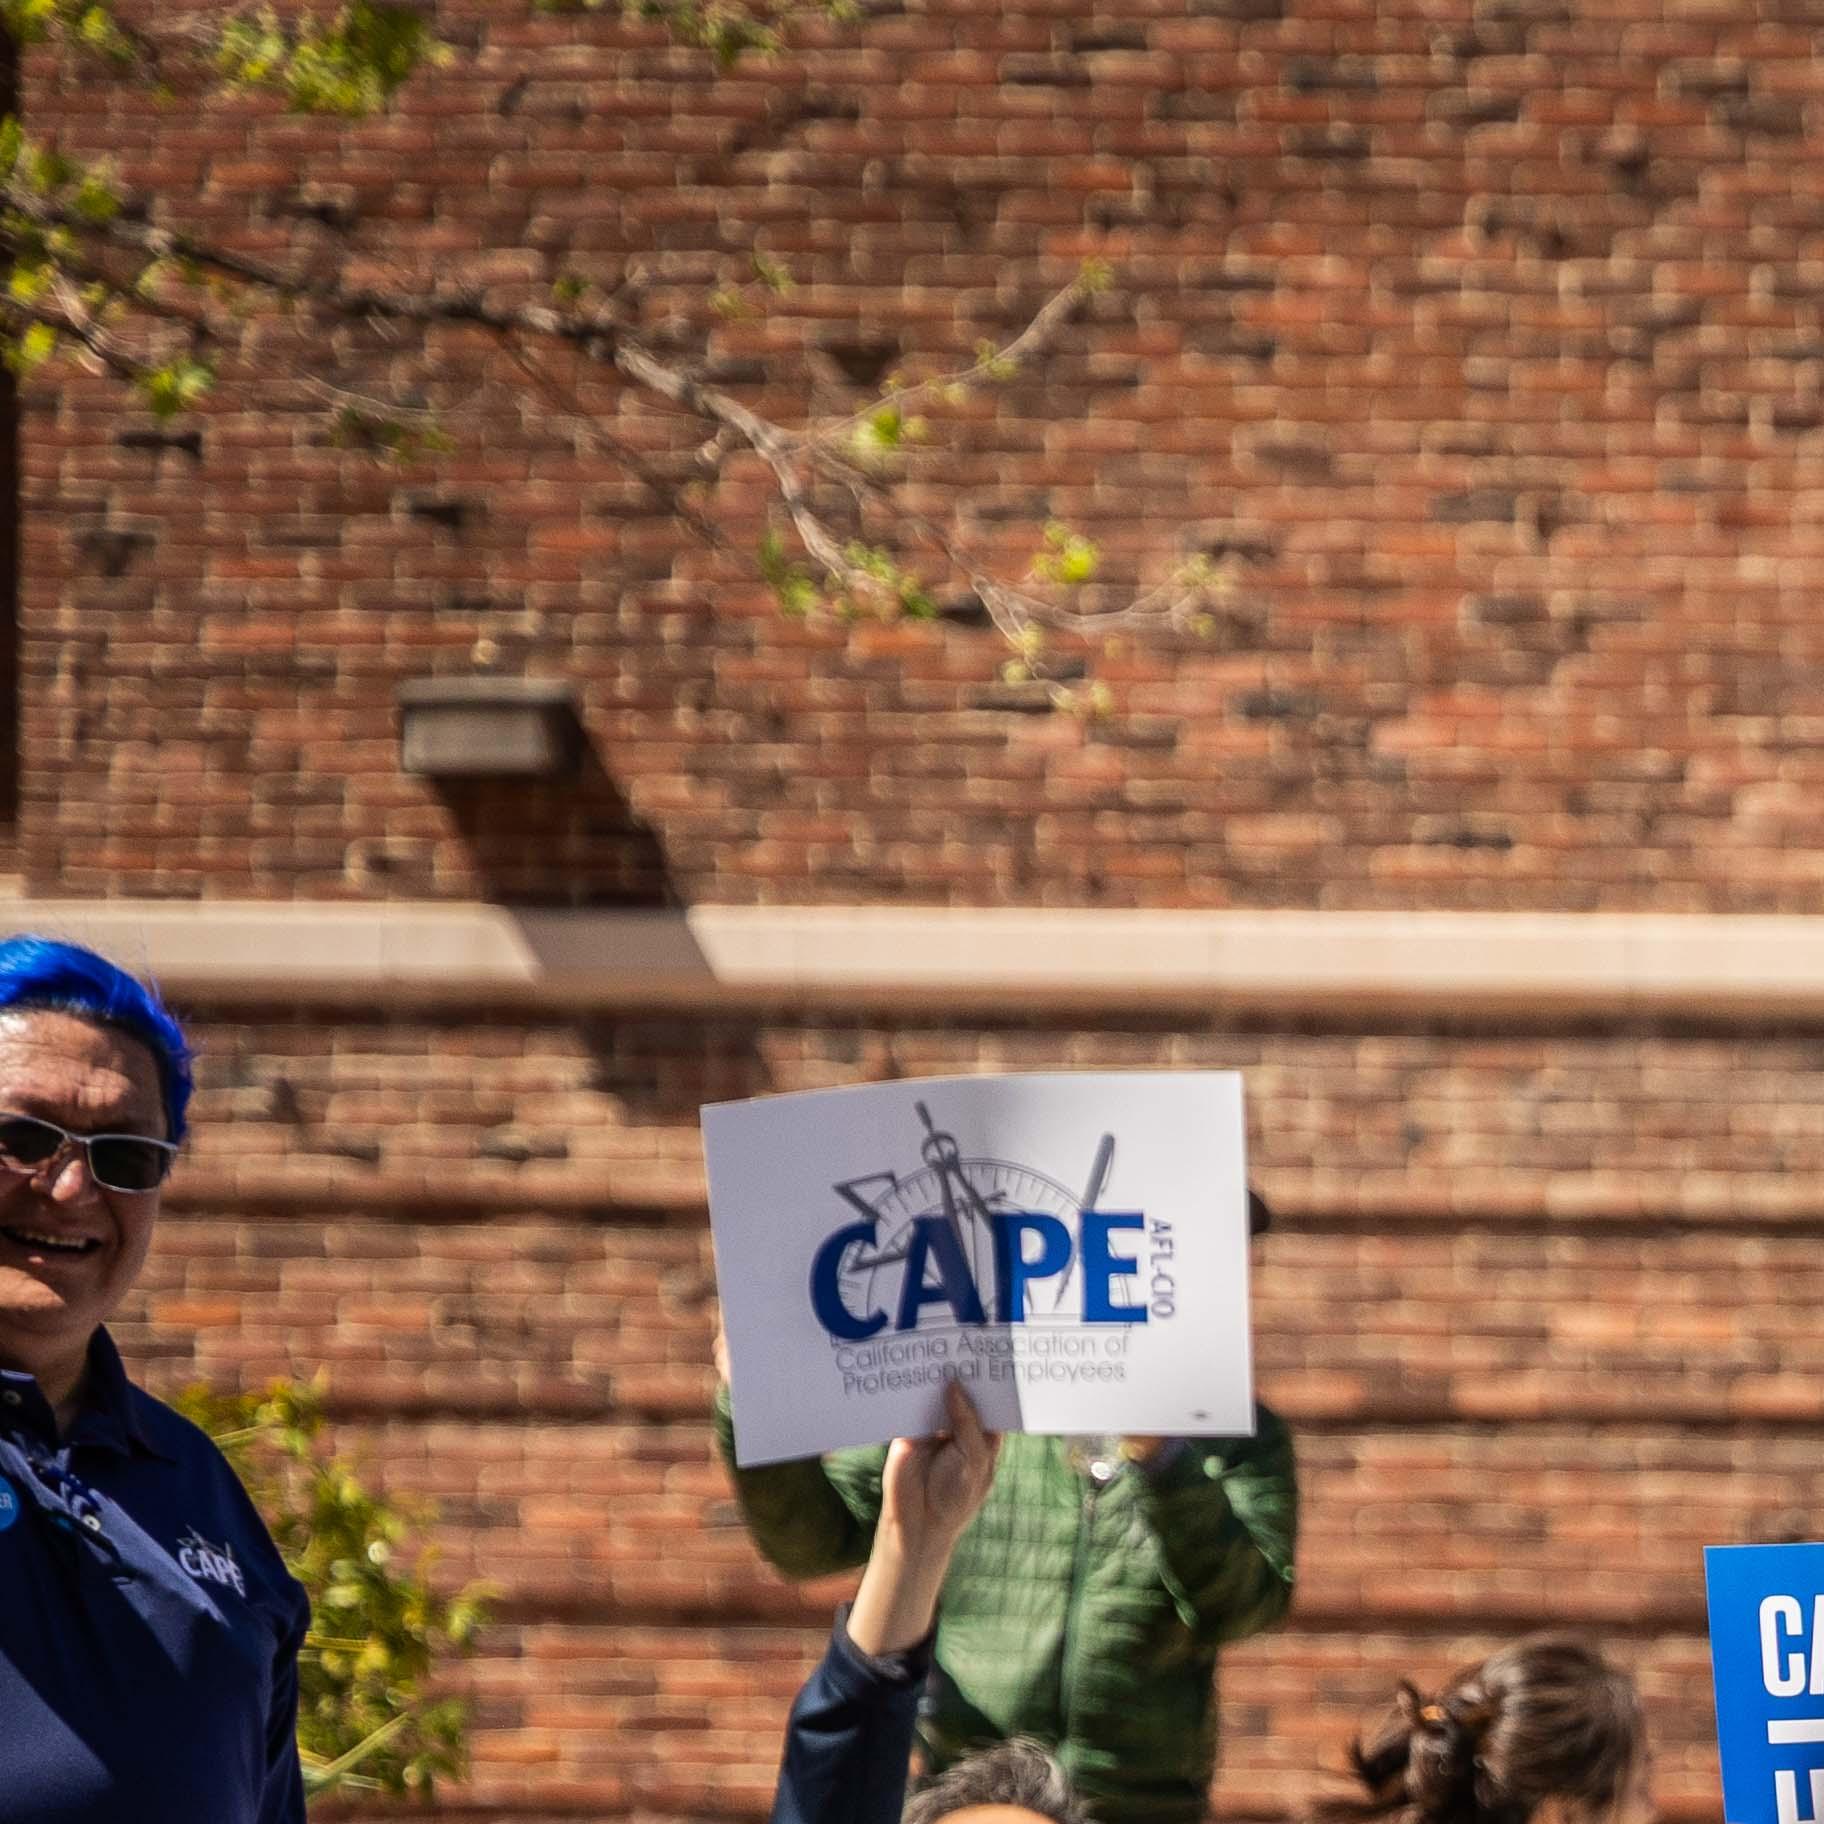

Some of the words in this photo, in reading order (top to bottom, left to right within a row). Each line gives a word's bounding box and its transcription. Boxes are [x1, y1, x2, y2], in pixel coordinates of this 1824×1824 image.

[810, 1211, 1148, 1341] CAPE
[1150, 1219, 1174, 1319] AFL-CIO
[835, 1334, 948, 1371] California
[956, 1332, 1097, 1360] Association
[1103, 1333, 1130, 1355] of
[842, 1357, 980, 1394] Professional
[989, 1356, 1126, 1383] Employees
